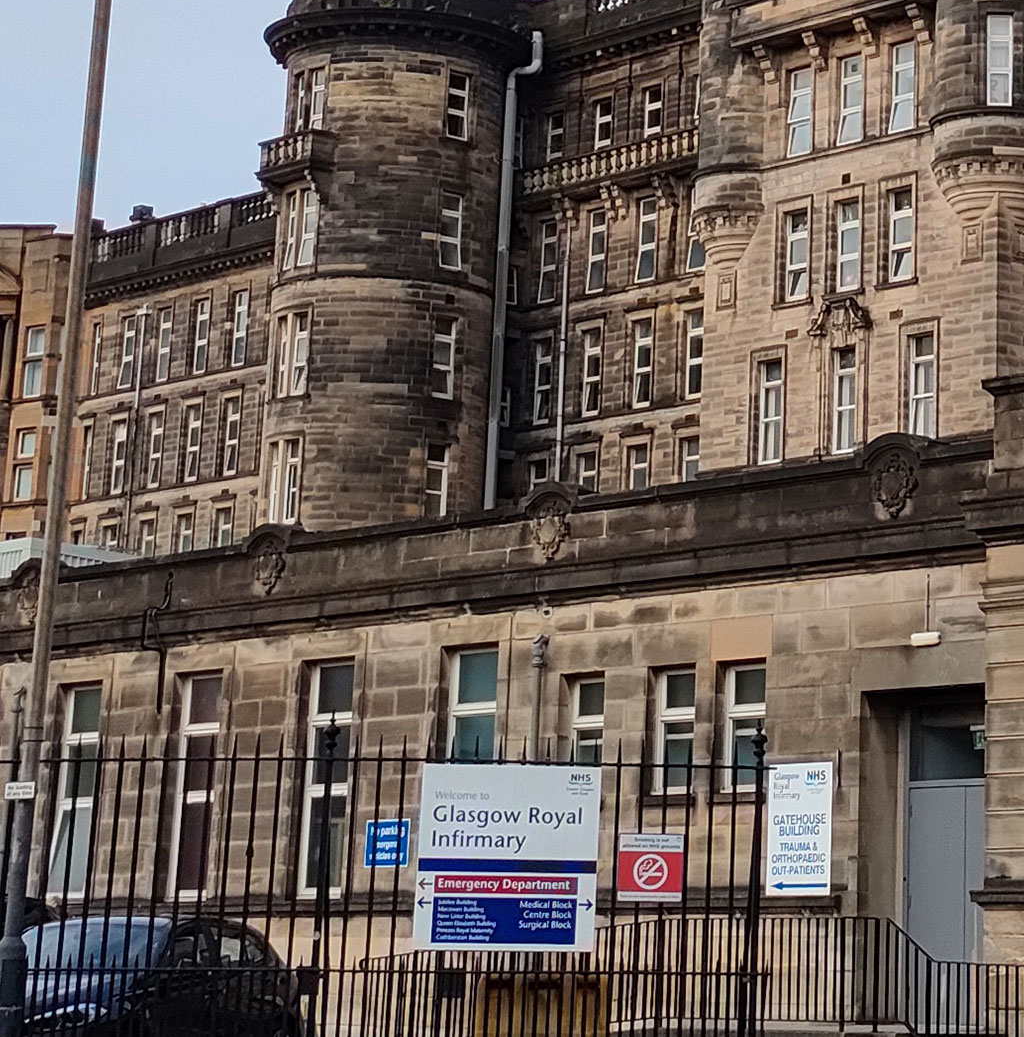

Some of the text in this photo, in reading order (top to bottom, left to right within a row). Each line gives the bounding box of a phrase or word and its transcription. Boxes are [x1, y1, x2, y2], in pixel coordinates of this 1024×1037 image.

[570, 773, 592, 782] NHS
[773, 772, 800, 783] Glasgow
[806, 770, 827, 781] NHS
[435, 790, 490, 801] Welcome to
[433, 804, 583, 830] Glasgow Royal
[773, 813, 827, 826] GATEHOUSE
[778, 825, 820, 837] BUILDING
[431, 829, 527, 854] Infirmary
[779, 841, 818, 852] TRAUMA &
[772, 853, 826, 864] ORTHOPAEDIC
[772, 864, 826, 876] OUT-PATIENTS
[437, 878, 571, 893] Emergency Department
[519, 900, 573, 909] Medical Block
[523, 910, 572, 919] Centre Block
[518, 919, 572, 931] Surgical Block
